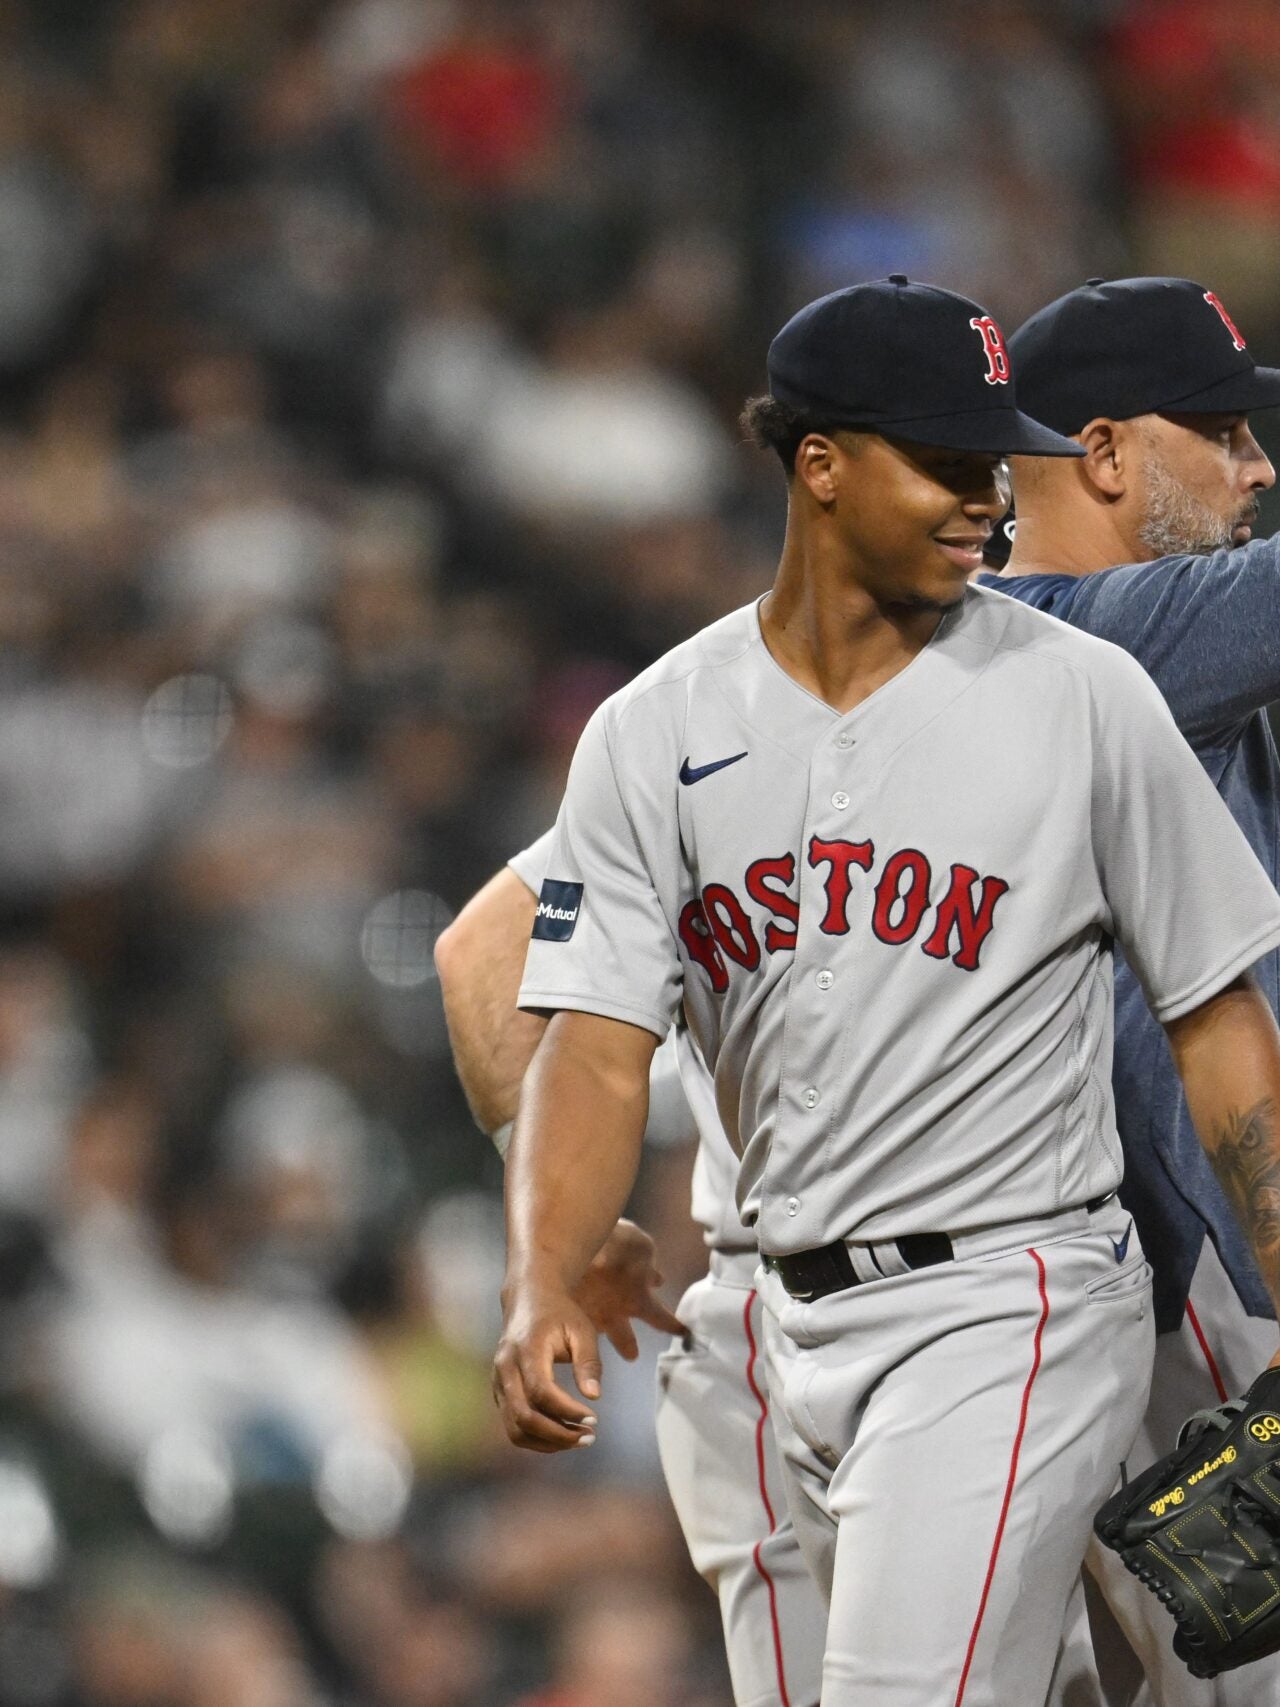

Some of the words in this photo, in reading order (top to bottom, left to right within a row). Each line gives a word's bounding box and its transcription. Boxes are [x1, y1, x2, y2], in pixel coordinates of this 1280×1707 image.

[969, 316, 1010, 385] B
[678, 834, 1010, 993] BOSTON
[1188, 1446, 1237, 1485] Brayan
[1150, 1488, 1185, 1516] Bello
